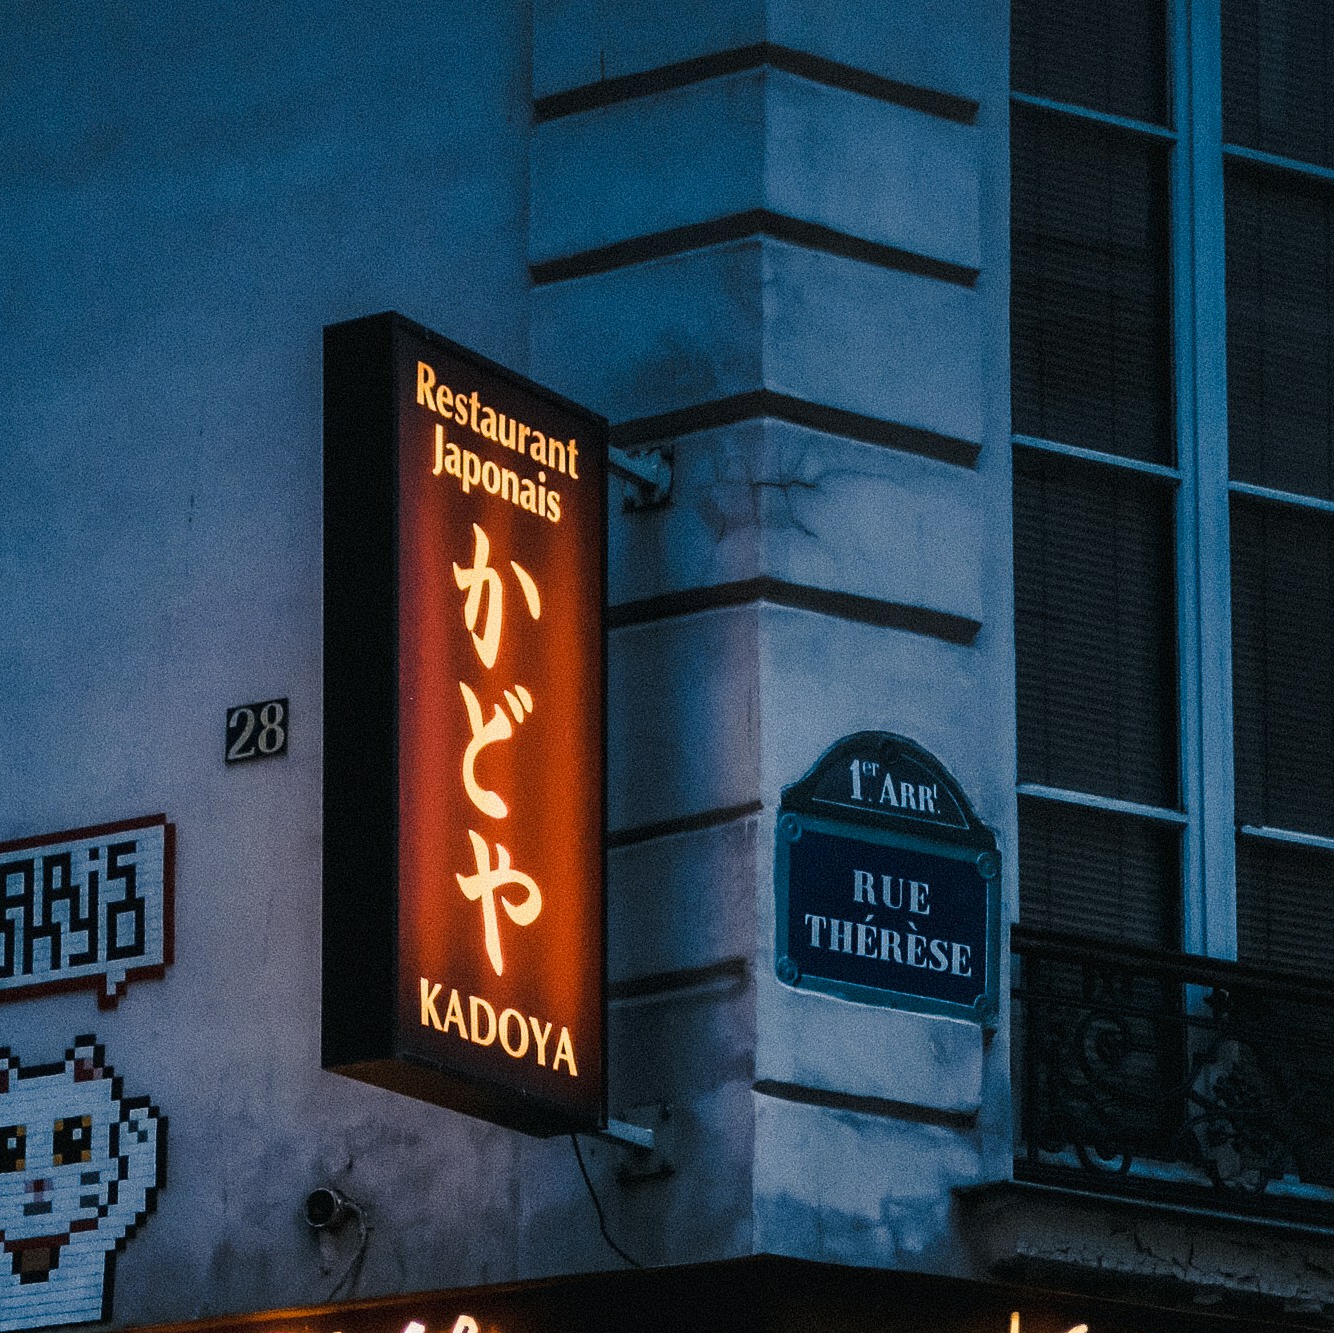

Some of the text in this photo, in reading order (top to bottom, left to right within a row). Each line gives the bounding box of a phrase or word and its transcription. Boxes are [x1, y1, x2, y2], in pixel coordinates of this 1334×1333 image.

[417, 361, 579, 479] Restaurant
[432, 423, 562, 523] Japonais
[228, 702, 285, 760] 28
[453, 522, 543, 976] かどや
[853, 869, 931, 916] RUE
[804, 914, 973, 978] THÉRÈSE
[419, 976, 579, 1077] KADOYA
